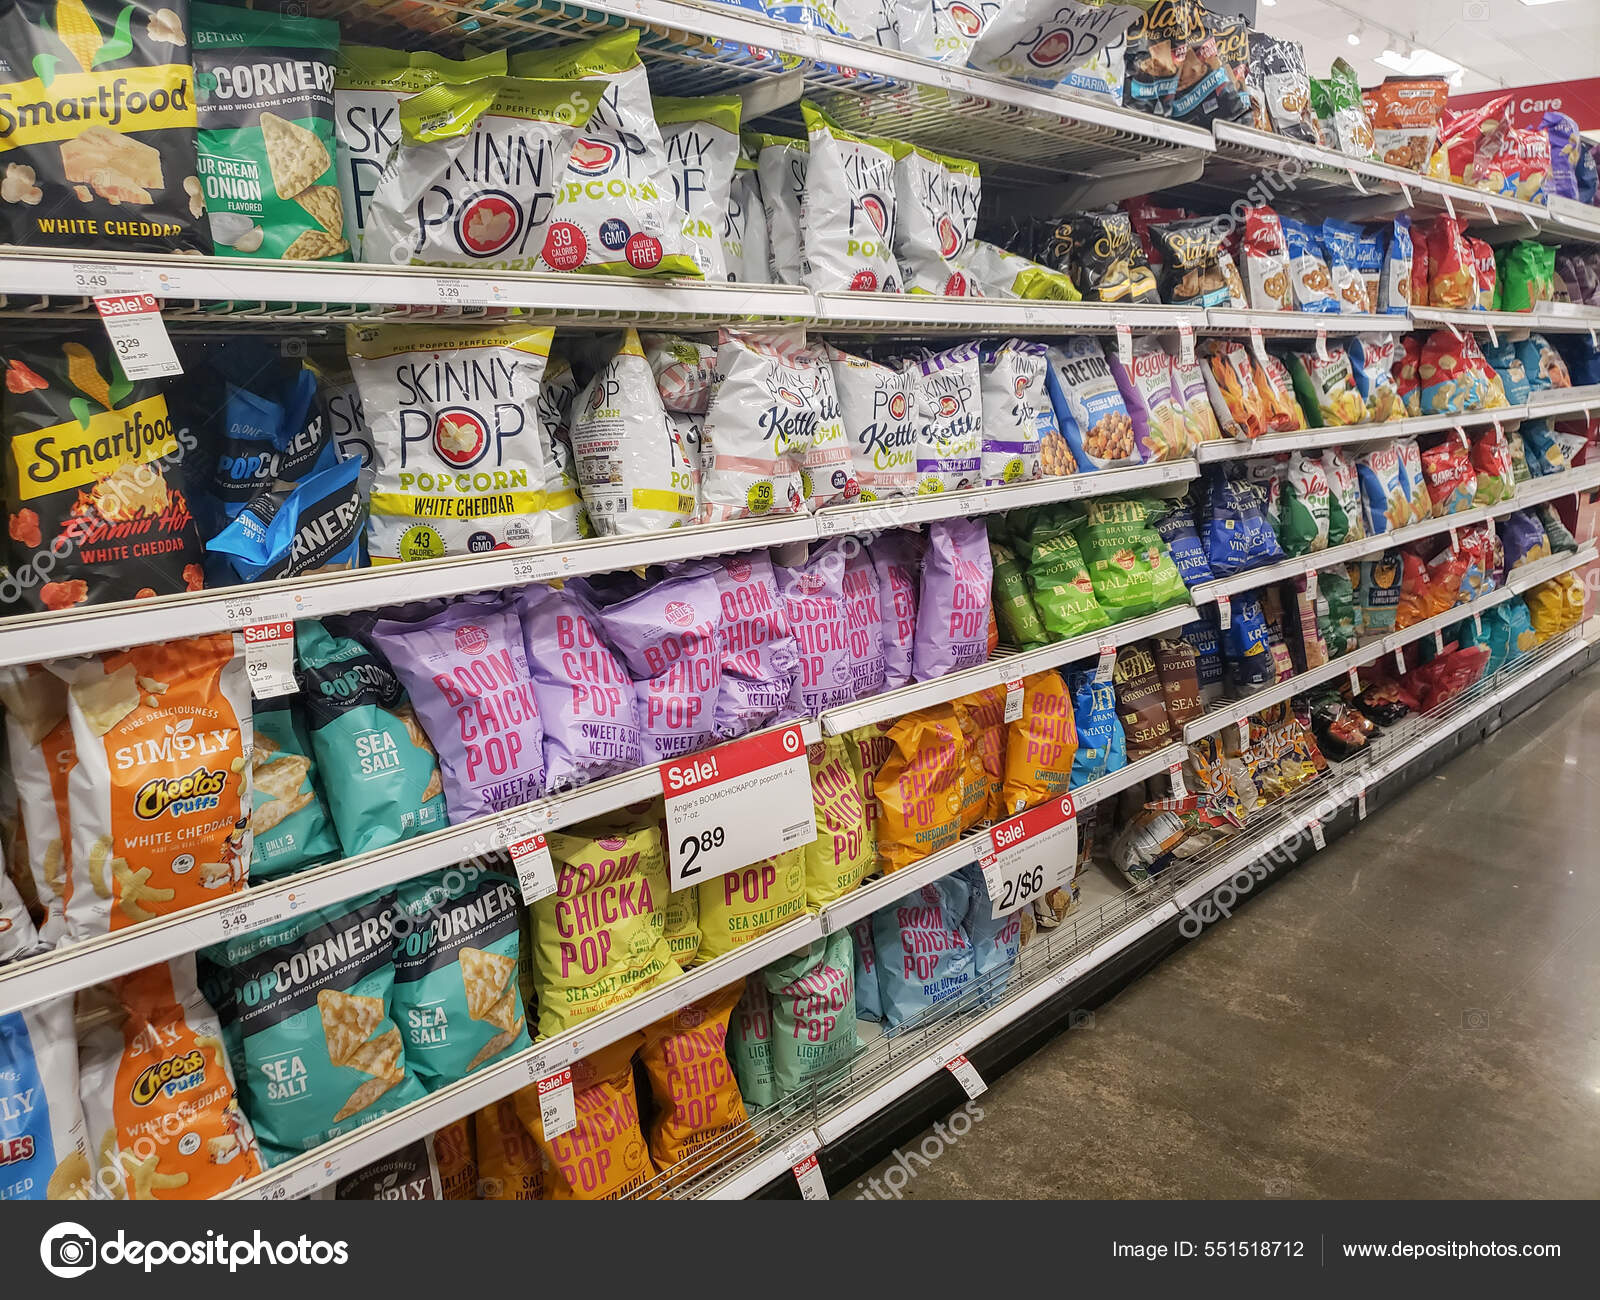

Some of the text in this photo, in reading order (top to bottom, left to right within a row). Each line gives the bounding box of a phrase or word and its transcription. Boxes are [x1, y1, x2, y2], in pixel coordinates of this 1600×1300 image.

[0, 78, 188, 139] Smartfood
[218, 100, 281, 111] AND WHOLESOME
[1520, 98, 1562, 116] Care
[218, 160, 258, 180] CREAM
[207, 175, 262, 201] ONION
[227, 201, 263, 213] FLAVORED
[37, 218, 182, 238] WHITE CHEDDAR
[418, 184, 556, 260] POP
[607, 222, 620, 231] NON
[552, 227, 572, 248] 39
[604, 233, 627, 246] GMO
[632, 239, 654, 249] GLUTEN
[551, 245, 578, 258] CALORIES
[554, 254, 578, 265] PER CUP
[631, 248, 659, 265] FREE
[75, 275, 107, 286] 3.49
[438, 287, 459, 298] 3.29
[100, 298, 143, 315] Sale!
[419, 341, 455, 351] POPPED
[850, 361, 869, 369] NEW!
[1125, 352, 1170, 387] Veggie
[396, 356, 519, 406] SKINNY
[929, 387, 972, 422] POP
[400, 403, 526, 471] POP
[922, 415, 981, 445] Kettle
[874, 446, 914, 471] Corn
[937, 461, 957, 472] SWEET
[962, 459, 976, 470] SALTY
[400, 469, 528, 493] POPCORN
[758, 486, 771, 498] 56
[927, 481, 938, 492] 56
[414, 494, 516, 517] WHITE CHEDDAR
[158, 512, 192, 533] Hot
[822, 520, 835, 530] 3.29
[81, 537, 184, 565] WHITE CHEDDAR
[414, 532, 430, 548] 43
[472, 541, 492, 552] GMO
[1175, 549, 1190, 560] SEA
[513, 564, 533, 575] 3.29
[227, 606, 253, 619] 3.49
[665, 604, 695, 624] ANGIE'S
[245, 624, 281, 641] Sale!
[949, 611, 982, 638] POP
[454, 627, 488, 649] ANGIE'S
[951, 643, 975, 656] SWEET
[1197, 640, 1217, 652] CUT
[1163, 659, 1196, 671] POTATO
[432, 648, 520, 707] BOOM
[570, 683, 621, 718] POP
[1171, 698, 1194, 712] SEA
[120, 706, 219, 735] PURE DELICIOUSNESS
[648, 696, 703, 729] POP
[581, 723, 627, 742] SWEET &
[656, 734, 694, 752] SWEET
[1134, 729, 1157, 744] SEA
[115, 727, 234, 771] SIMPLY
[355, 732, 395, 757] SEA
[588, 740, 623, 760] KETTLE
[1026, 741, 1062, 768] POP
[361, 750, 401, 774] SALT
[466, 730, 523, 783] POP
[668, 755, 719, 790] Sale!
[1034, 769, 1065, 783] CHEDDAR
[133, 765, 227, 821] Cheetos
[481, 774, 537, 804] SWEET &
[673, 799, 699, 814] Angie's
[699, 779, 758, 805] BOOMCHICKAPOP
[759, 771, 784, 786] popcorn
[172, 795, 218, 818] Puffs
[674, 810, 700, 825] to 7-oz.
[902, 799, 936, 829] POP
[124, 815, 234, 850] WHITE CHEDDAR
[264, 832, 295, 850] ONLY 3
[499, 826, 517, 838] 3.29
[915, 820, 948, 845] CHEDDAR
[995, 820, 1026, 848] Sale!
[510, 838, 538, 858] Sale!
[834, 832, 863, 867] POP
[556, 852, 642, 898] BOOM
[724, 865, 777, 906] POP
[999, 864, 1044, 911] 2/$6
[555, 878, 654, 939] CHICKA
[649, 911, 664, 927] 40
[728, 906, 775, 931] SEA SALT
[897, 906, 944, 930] BOOM
[221, 914, 248, 930] 3.49
[437, 912, 514, 954] WHOLESOME POPPED-CORN
[259, 924, 301, 948] BETTER!
[902, 928, 966, 954] CHICKA
[560, 930, 612, 979] POP
[904, 953, 939, 980] POP
[246, 941, 393, 1021] CRUNCHY AND WHOLESOME POPPED-CORN SNACK
[565, 974, 617, 1004] SEA SALT
[923, 973, 969, 996] REAL BUTTER
[408, 1006, 448, 1028] SEA
[793, 1015, 836, 1042] POP
[410, 1021, 450, 1044] SALT
[661, 1021, 726, 1070] BOOM
[796, 1045, 825, 1058] LIGHT
[260, 1056, 308, 1082] SEA
[529, 1060, 546, 1075] 3.29
[267, 1077, 310, 1101] SALT
[538, 1075, 564, 1094] Sale!
[671, 1093, 718, 1131] POP
[560, 1148, 612, 1192] POP
[794, 1161, 812, 1178] Sale!
